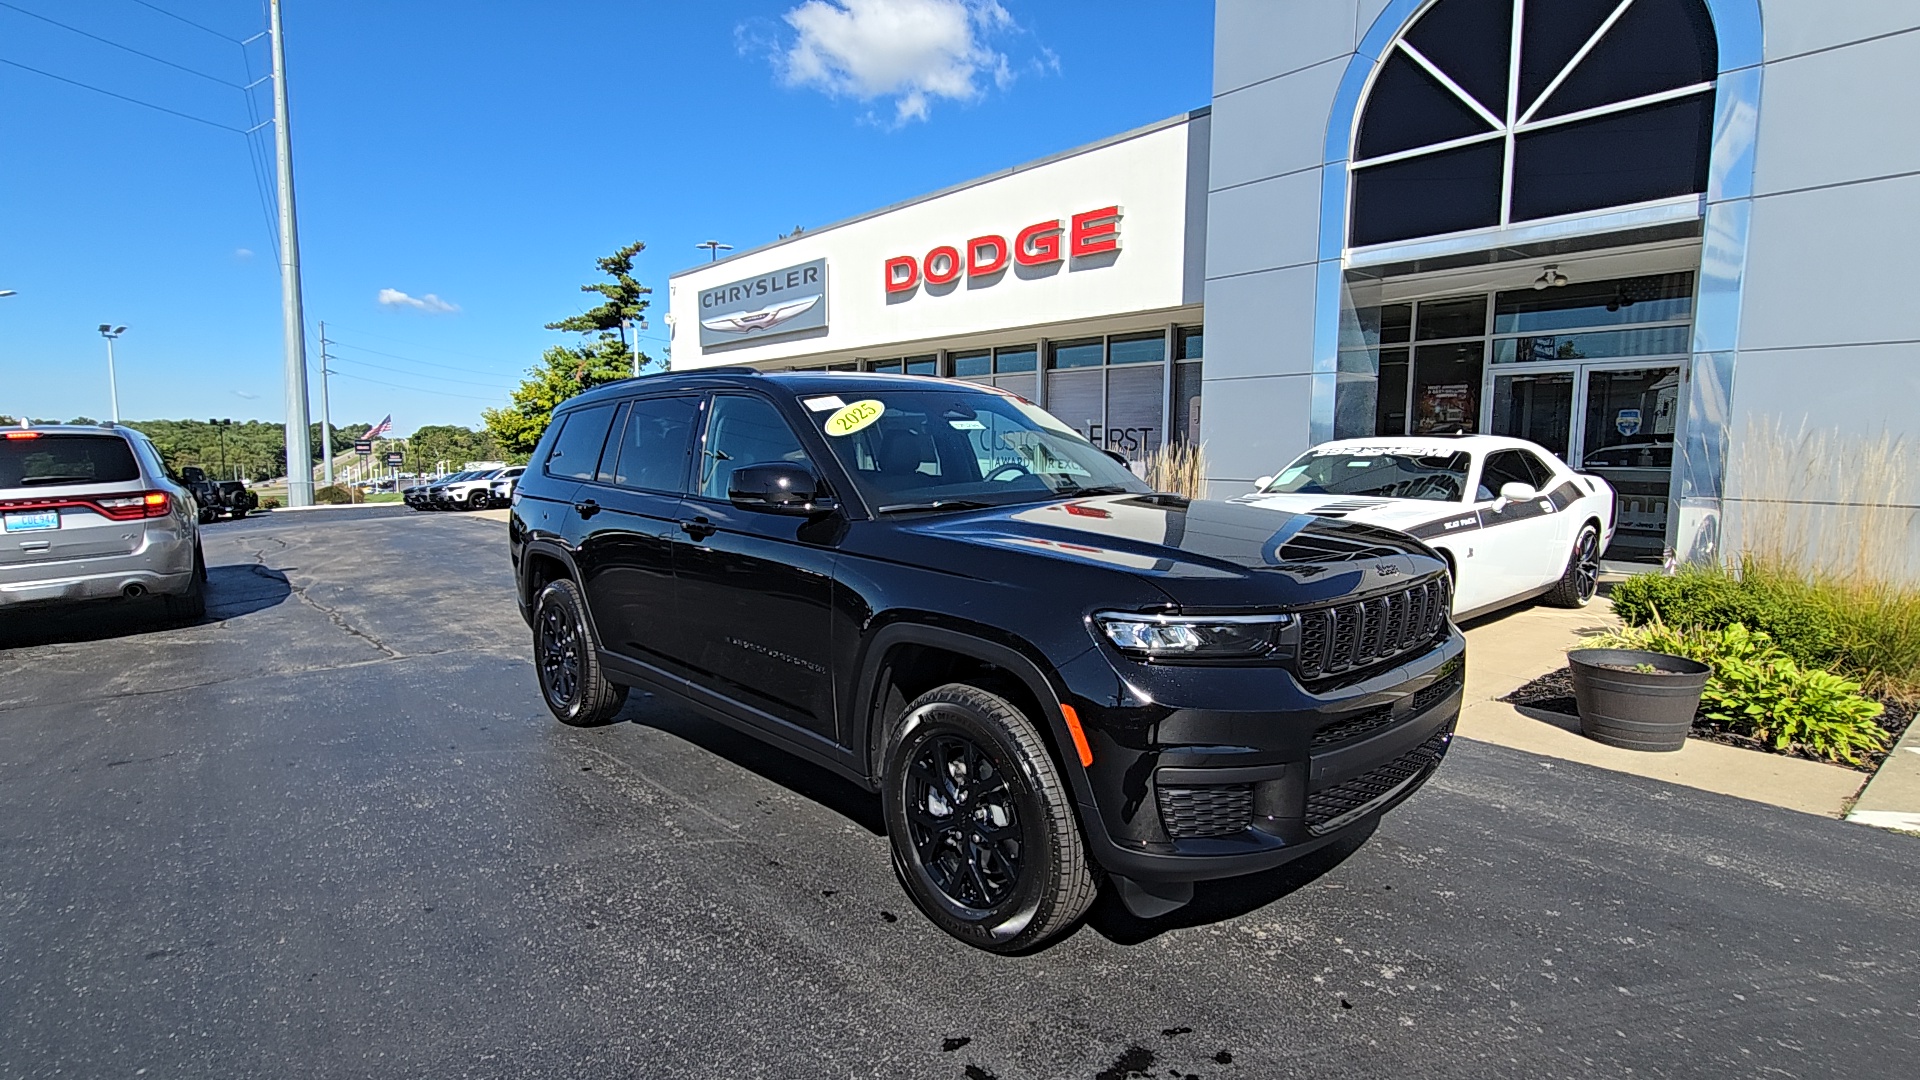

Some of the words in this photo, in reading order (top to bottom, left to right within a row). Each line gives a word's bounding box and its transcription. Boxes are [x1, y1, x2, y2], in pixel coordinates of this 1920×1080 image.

[884, 206, 1123, 294] DODGE
[702, 266, 819, 309] CHRYSLER
[836, 403, 877, 431] 2025
[1089, 424, 1154, 451] FIRST
